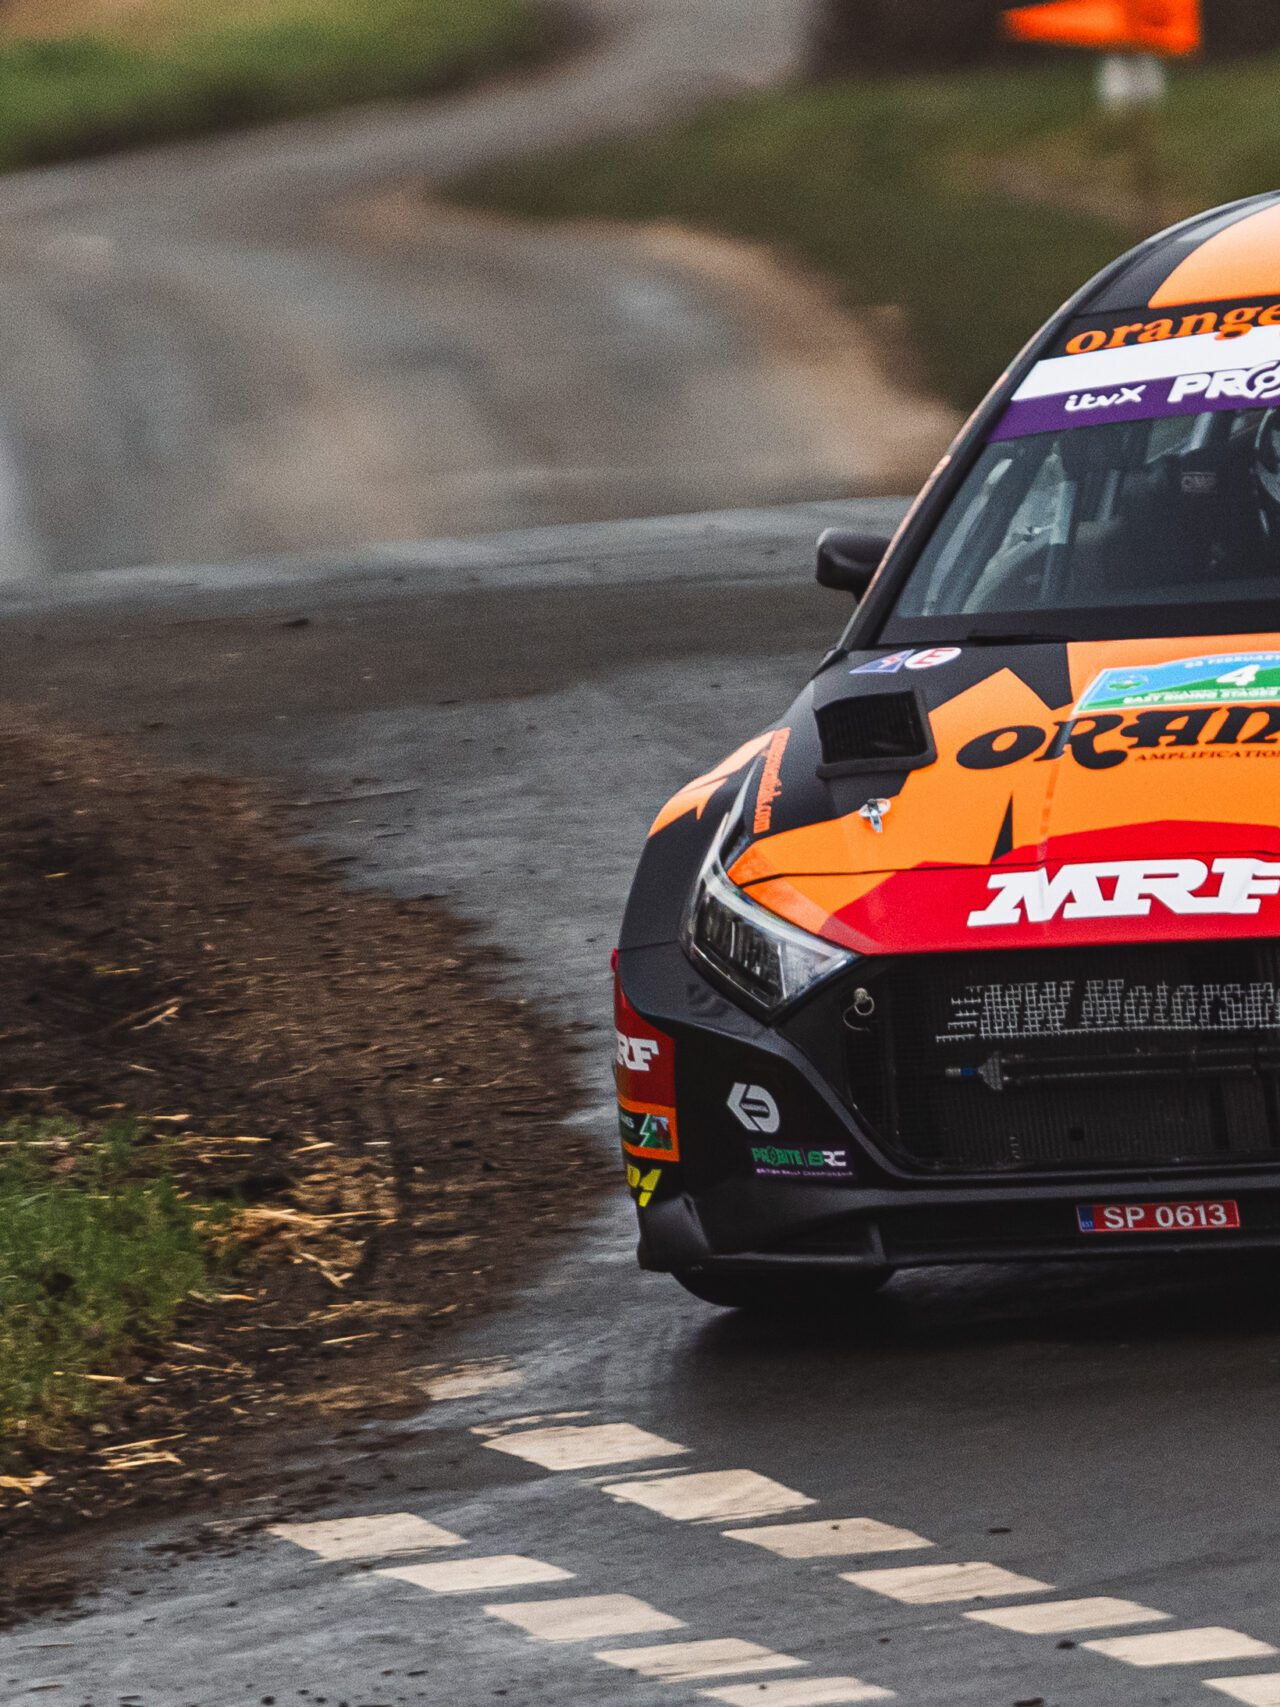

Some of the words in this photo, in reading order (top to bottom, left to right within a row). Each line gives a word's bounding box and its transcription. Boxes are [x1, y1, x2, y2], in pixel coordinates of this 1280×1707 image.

[1064, 384, 1147, 412] itvX
[1215, 663, 1260, 687] 4
[617, 1034, 660, 1072] RF
[807, 1150, 847, 1166] BRC
[1103, 1206, 1145, 1229] SP
[1155, 1203, 1228, 1228] 0613
